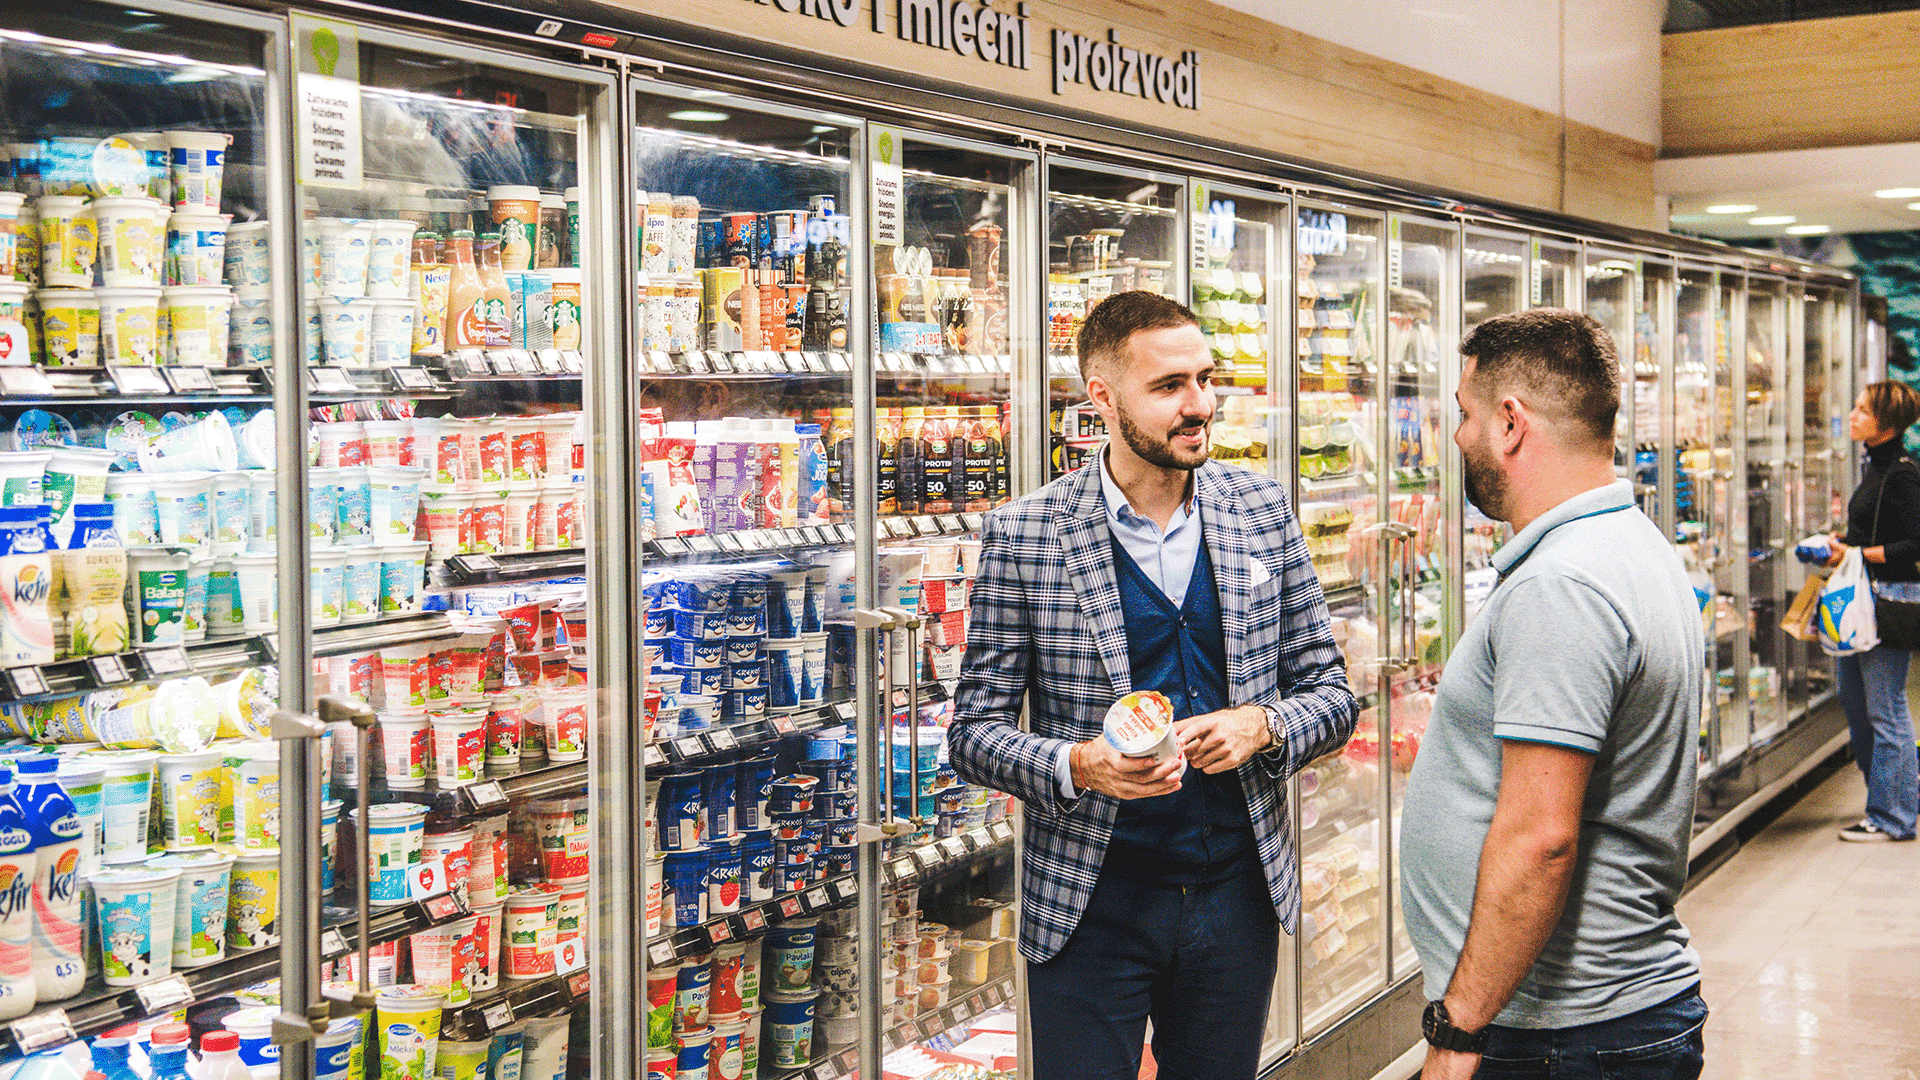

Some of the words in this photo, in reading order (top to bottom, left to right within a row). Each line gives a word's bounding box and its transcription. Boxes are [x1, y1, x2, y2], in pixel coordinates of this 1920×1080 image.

[898, 0, 1030, 70] mlečni
[1053, 28, 1200, 110] proizvodi
[711, 865, 741, 880] GREK
